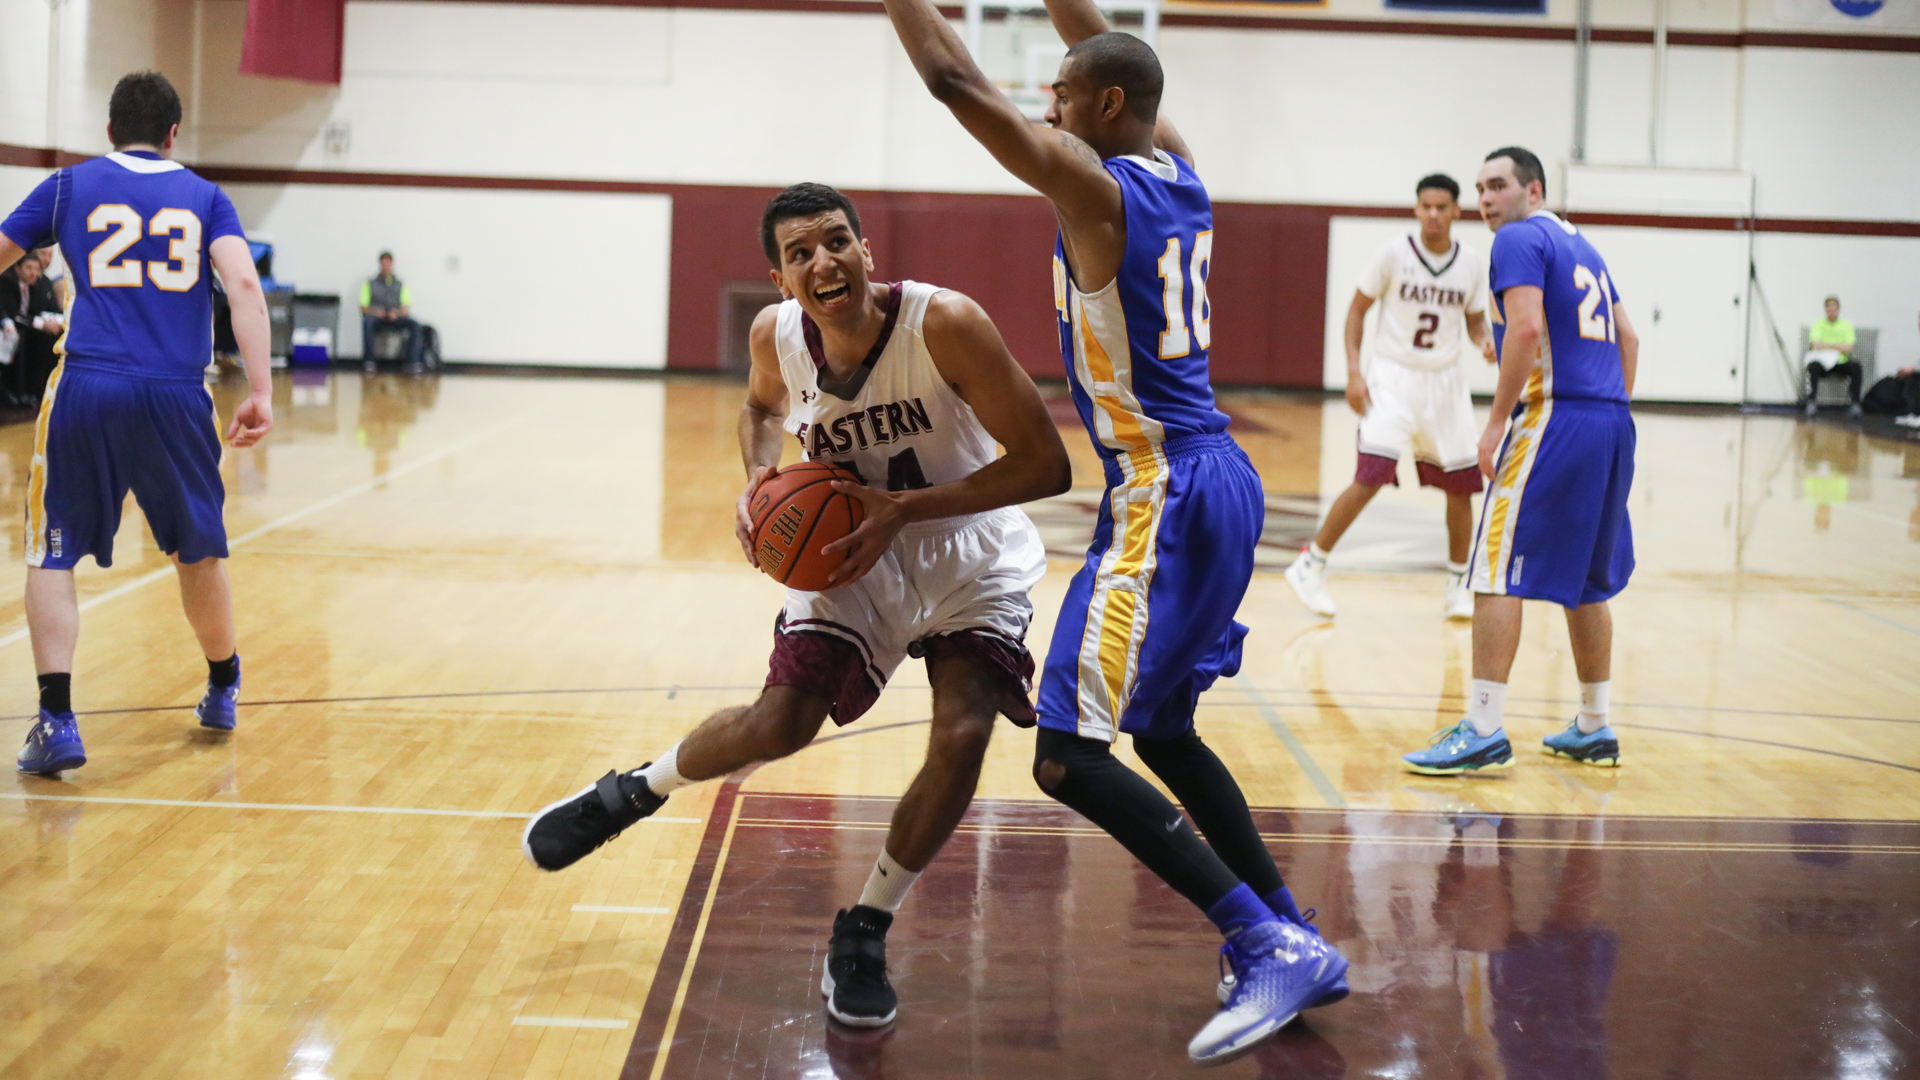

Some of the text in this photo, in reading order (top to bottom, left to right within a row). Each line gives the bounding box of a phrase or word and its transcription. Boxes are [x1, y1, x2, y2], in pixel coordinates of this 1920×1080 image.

[86, 203, 202, 292] 23
[1157, 229, 1213, 360] 10
[1399, 282, 1466, 308] EASTERN
[1573, 263, 1616, 345] 21
[1413, 312, 1439, 349] 2
[795, 397, 934, 460] EASTERN
[833, 446, 934, 491] 4
[770, 504, 806, 548] THE
